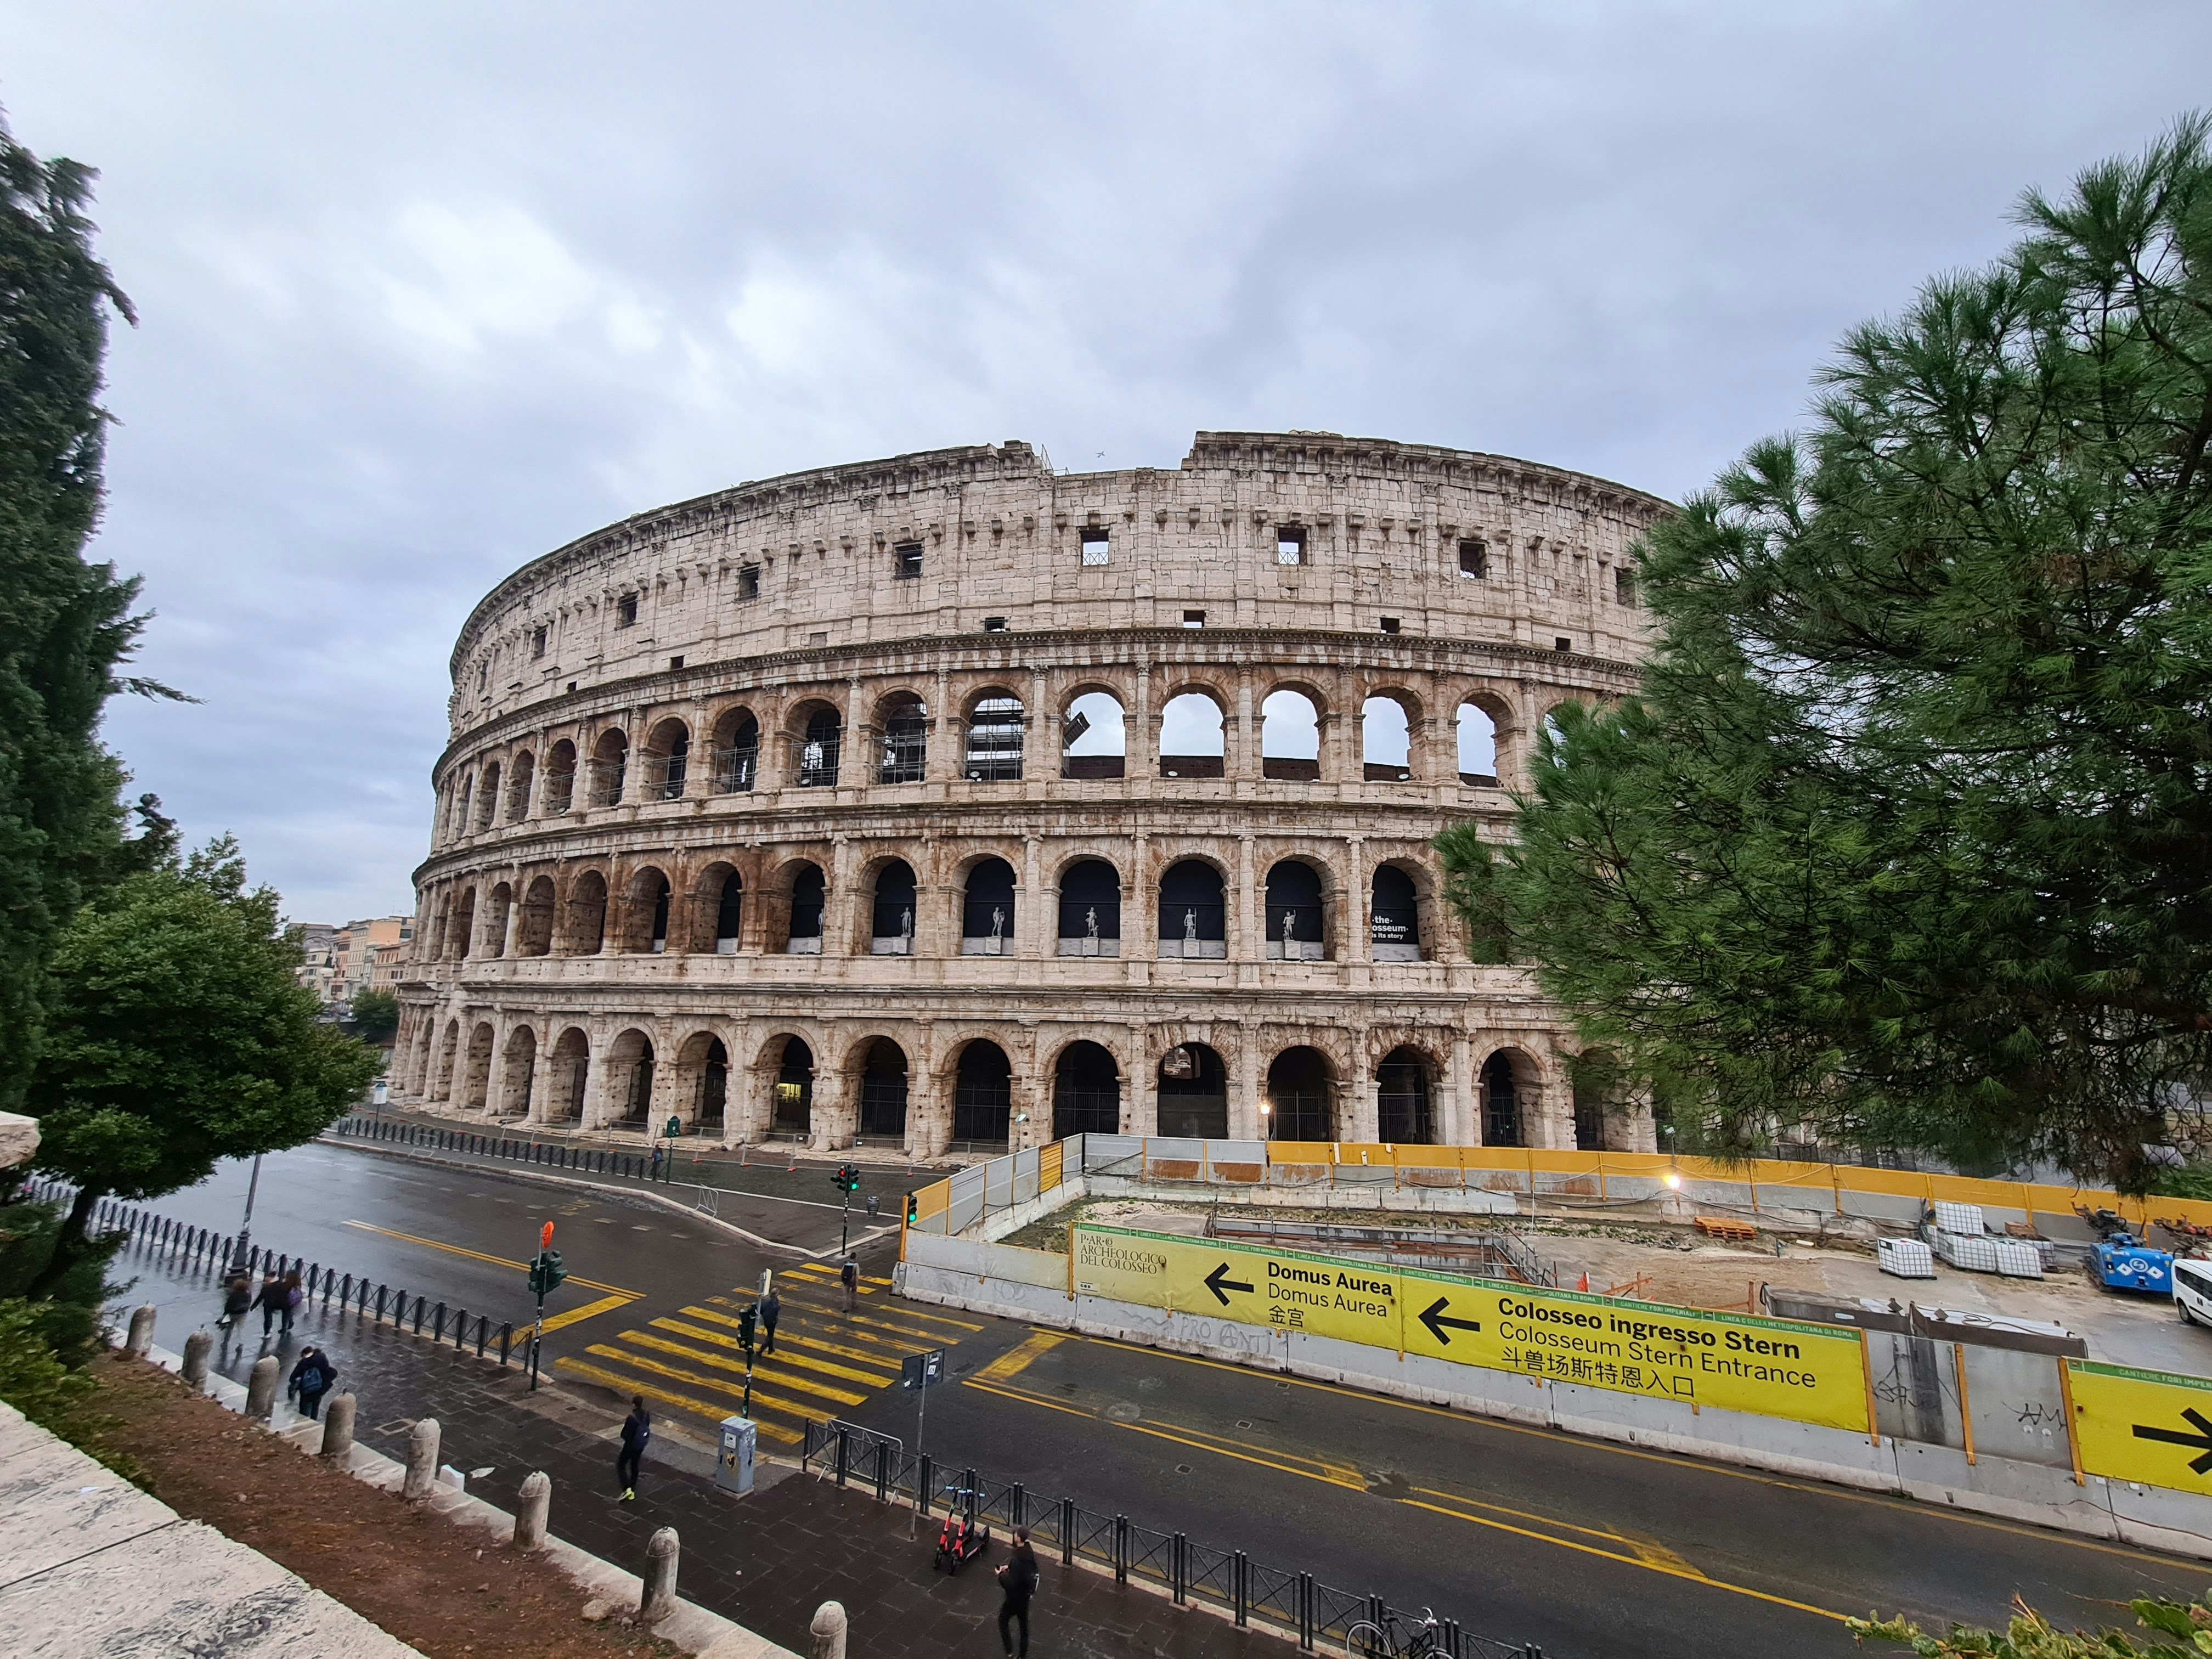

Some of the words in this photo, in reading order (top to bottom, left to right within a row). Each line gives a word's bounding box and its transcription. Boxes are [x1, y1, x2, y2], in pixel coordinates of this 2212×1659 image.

[1080, 1244, 1167, 1265] ARCHEOLOGICO
[1081, 1254, 1100, 1266] DEL
[1101, 1257, 1157, 1274] COLOSSEO
[1329, 1257, 1367, 1268] METROPOLITANA
[1268, 1261, 1331, 1286] Domus
[1336, 1272, 1392, 1296] Aurea
[1268, 1282, 1329, 1307] Domus
[1334, 1293, 1387, 1318] Aurea
[1620, 1301, 1648, 1310] CANTIERE
[1664, 1307, 1696, 1317] IMPERIALI
[1268, 1305, 1304, 1328] 金宫
[1498, 1297, 1602, 1329] Colosseo
[1610, 1314, 1716, 1346] ingresso
[1724, 1330, 1800, 1359] Stern
[1747, 1318, 1768, 1326] DELLA
[1768, 1321, 1823, 1334] METROPOLITANA
[1833, 1329, 1853, 1338] ROMA
[1499, 1321, 1621, 1357] Colosseum
[1628, 1341, 1693, 1369] Stern
[1701, 1352, 1816, 1388] Entrance
[1502, 1346, 1694, 1398] 斗兽场斯特恩入口
[2119, 1368, 2160, 1380] CANTIERE
[2162, 1374, 2182, 1384] FORI
[2183, 1378, 2212, 1389] IMPER
